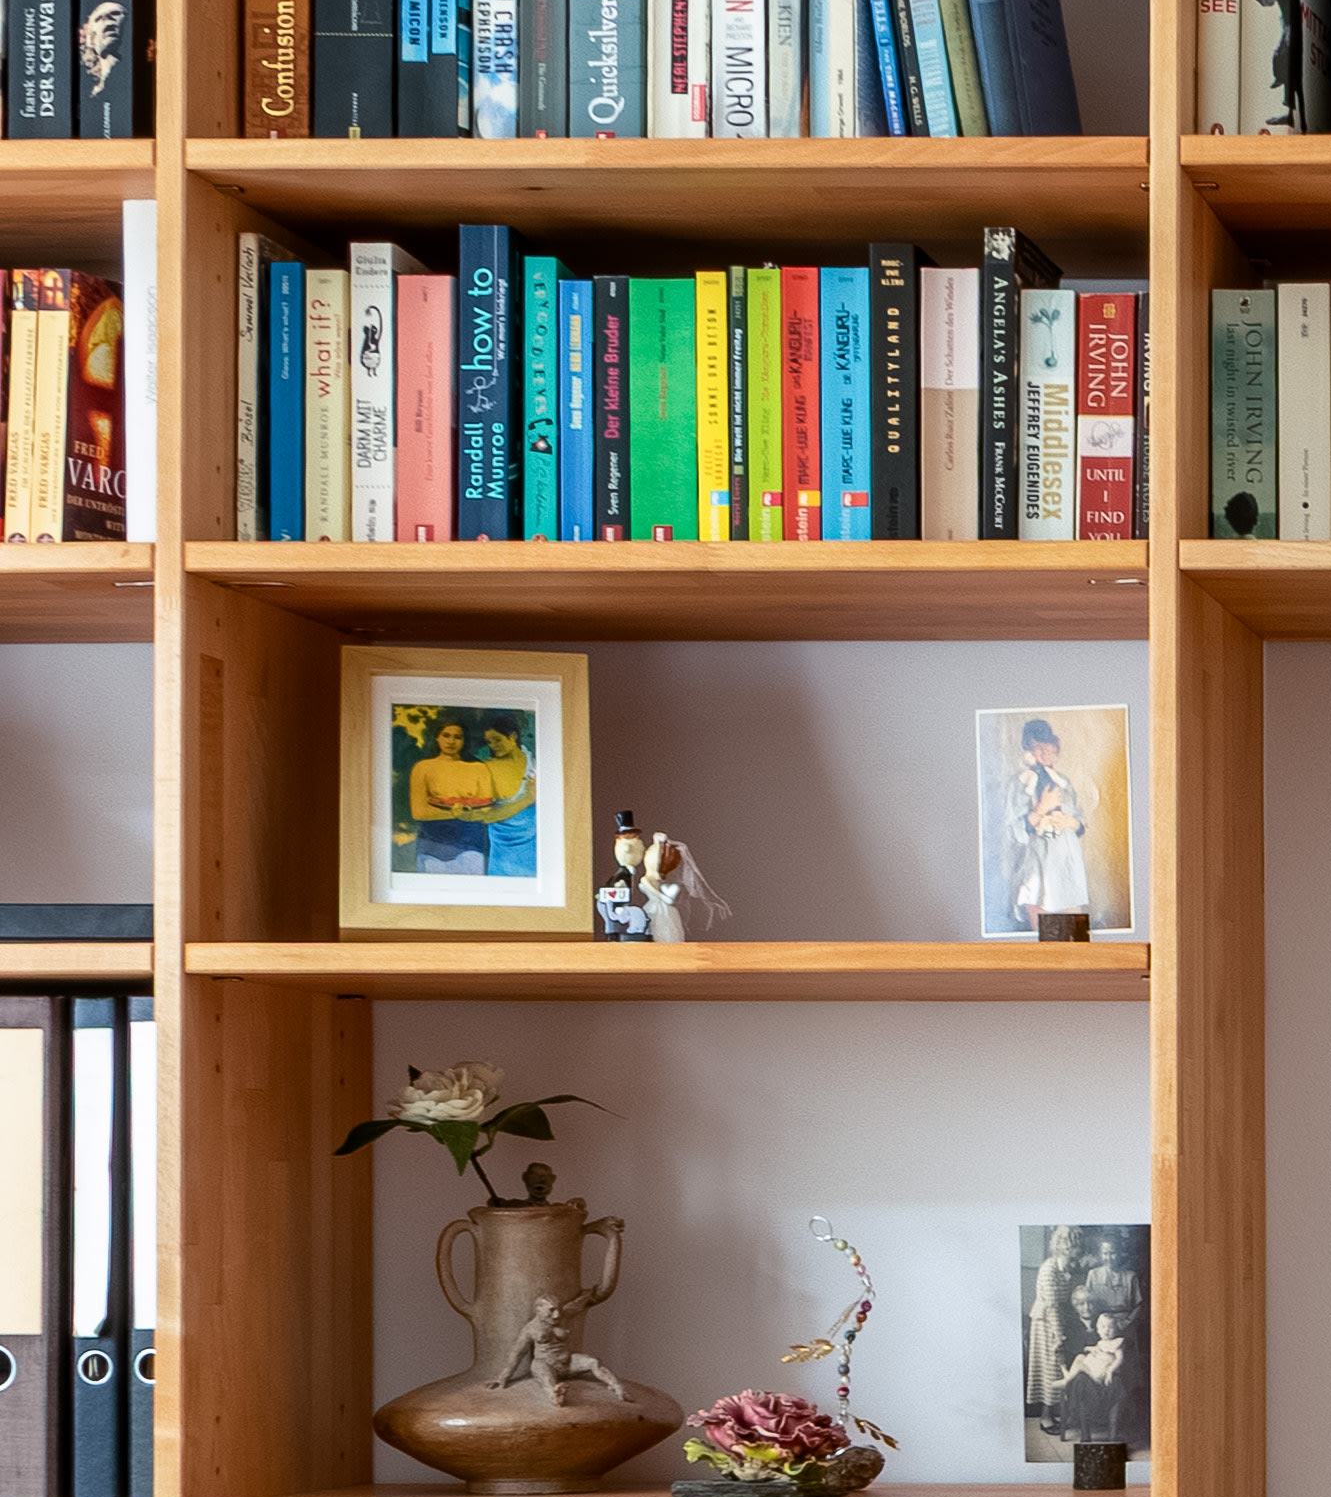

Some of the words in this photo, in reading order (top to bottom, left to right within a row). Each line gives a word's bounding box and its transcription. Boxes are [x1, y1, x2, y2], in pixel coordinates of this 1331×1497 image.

[898, 11, 911, 47] WORLDS
[1200, 0, 1236, 13] SEE
[262, 1, 294, 116] Confusion
[673, 60, 687, 93] NEAL
[725, 46, 754, 126] MICRO
[468, 268, 492, 297] to
[311, 300, 331, 329] if?
[461, 308, 493, 370] how
[604, 315, 620, 363] Bruder
[311, 341, 331, 398] what
[1087, 325, 1107, 407] IRVING
[1111, 334, 1128, 398] JOHN
[1246, 322, 1263, 387] JOHN
[604, 368, 620, 411] kleine
[888, 307, 900, 454] QUALITYLAND
[357, 400, 371, 425] MIT
[373, 407, 387, 462] CHARME
[604, 414, 620, 439] Der
[1026, 382, 1041, 439] JEFFREY
[74, 441, 104, 460] FRED
[357, 428, 372, 468] DARM
[465, 423, 484, 499] Randall
[487, 423, 505, 499] Munroe
[1043, 383, 1069, 520] Middlesex
[1246, 396, 1263, 484] IRVING
[608, 452, 620, 490] Regener
[1026, 445, 1041, 520] EUGENIDES
[1087, 469, 1126, 481] UNTIL
[608, 493, 618, 515] Sven
[1087, 512, 1124, 523] FIND
